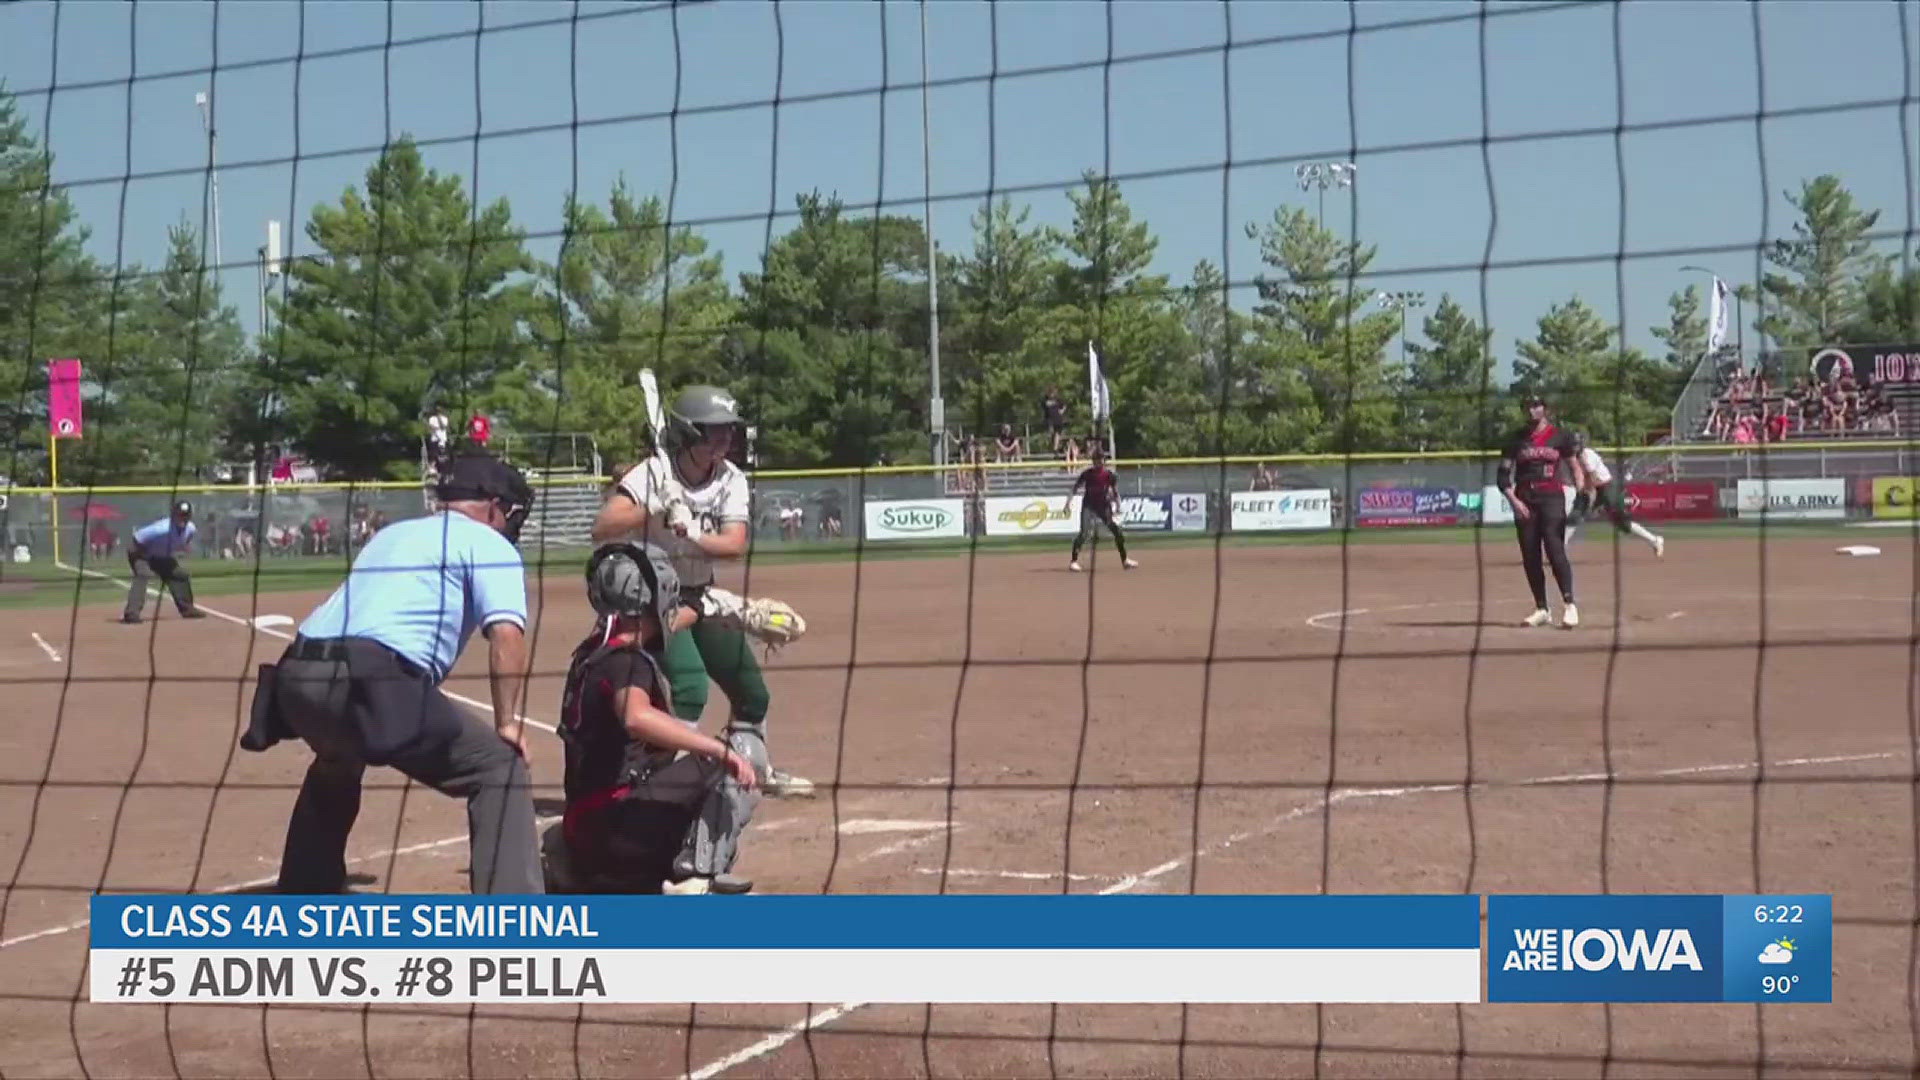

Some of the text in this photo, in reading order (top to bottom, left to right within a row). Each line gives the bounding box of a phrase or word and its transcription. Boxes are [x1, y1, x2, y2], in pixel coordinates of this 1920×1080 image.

[1232, 497, 1329, 513] FLEET FEET
[1797, 494, 1839, 509] ARMY
[883, 507, 946, 529] Sukup
